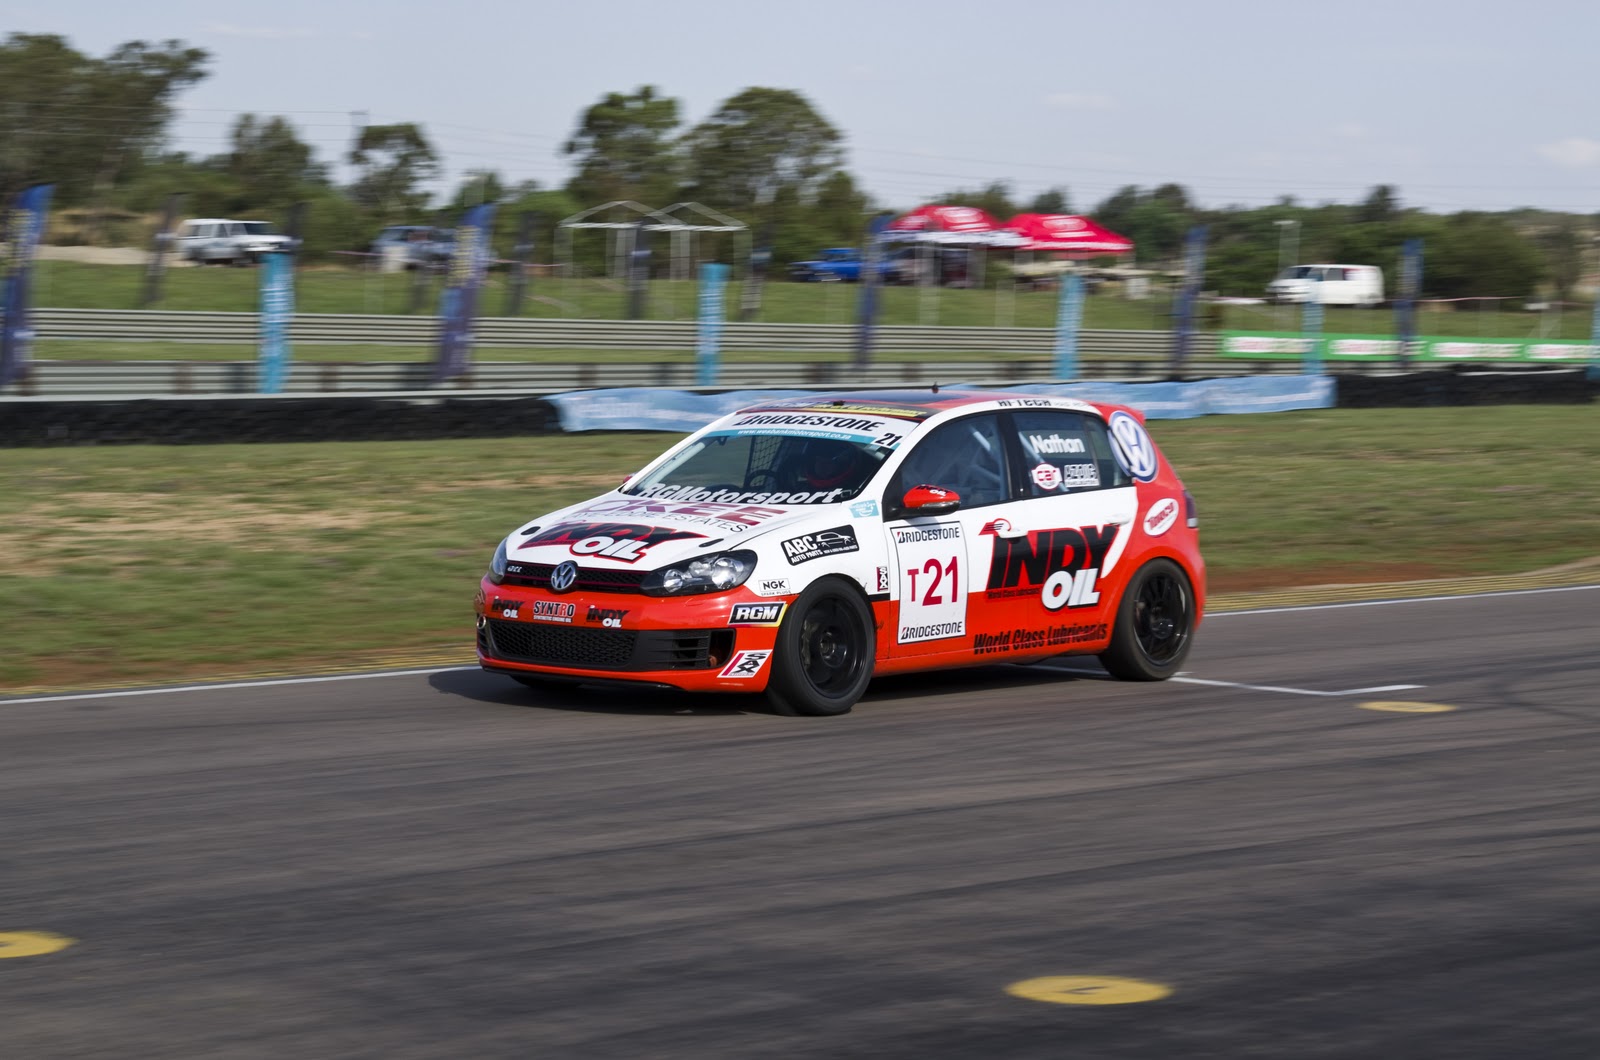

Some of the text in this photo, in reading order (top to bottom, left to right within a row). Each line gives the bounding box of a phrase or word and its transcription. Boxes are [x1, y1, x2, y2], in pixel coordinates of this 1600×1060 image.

[732, 414, 885, 432] BRIDGESTONE
[875, 432, 902, 447] 21
[1029, 434, 1086, 454] Nathan
[638, 483, 843, 505] RGMotorsport
[897, 527, 960, 544] BRIDGESTONE
[571, 536, 649, 561] OIL
[783, 535, 818, 557] ABC
[790, 554, 807, 564] AUTO
[805, 549, 823, 559] PARTS
[986, 524, 1119, 590] INDY
[763, 580, 786, 590] NGK
[1041, 568, 1100, 610] OIL
[503, 609, 518, 618] OIL
[534, 601, 575, 617] SYNTRO
[586, 605, 630, 622] INDY
[735, 606, 778, 620] RGM
[602, 618, 622, 628] OIL
[901, 622, 962, 640] BRIDGESTONE
[974, 623, 1108, 655] World Class Lubricants
[731, 652, 767, 674] SAX
